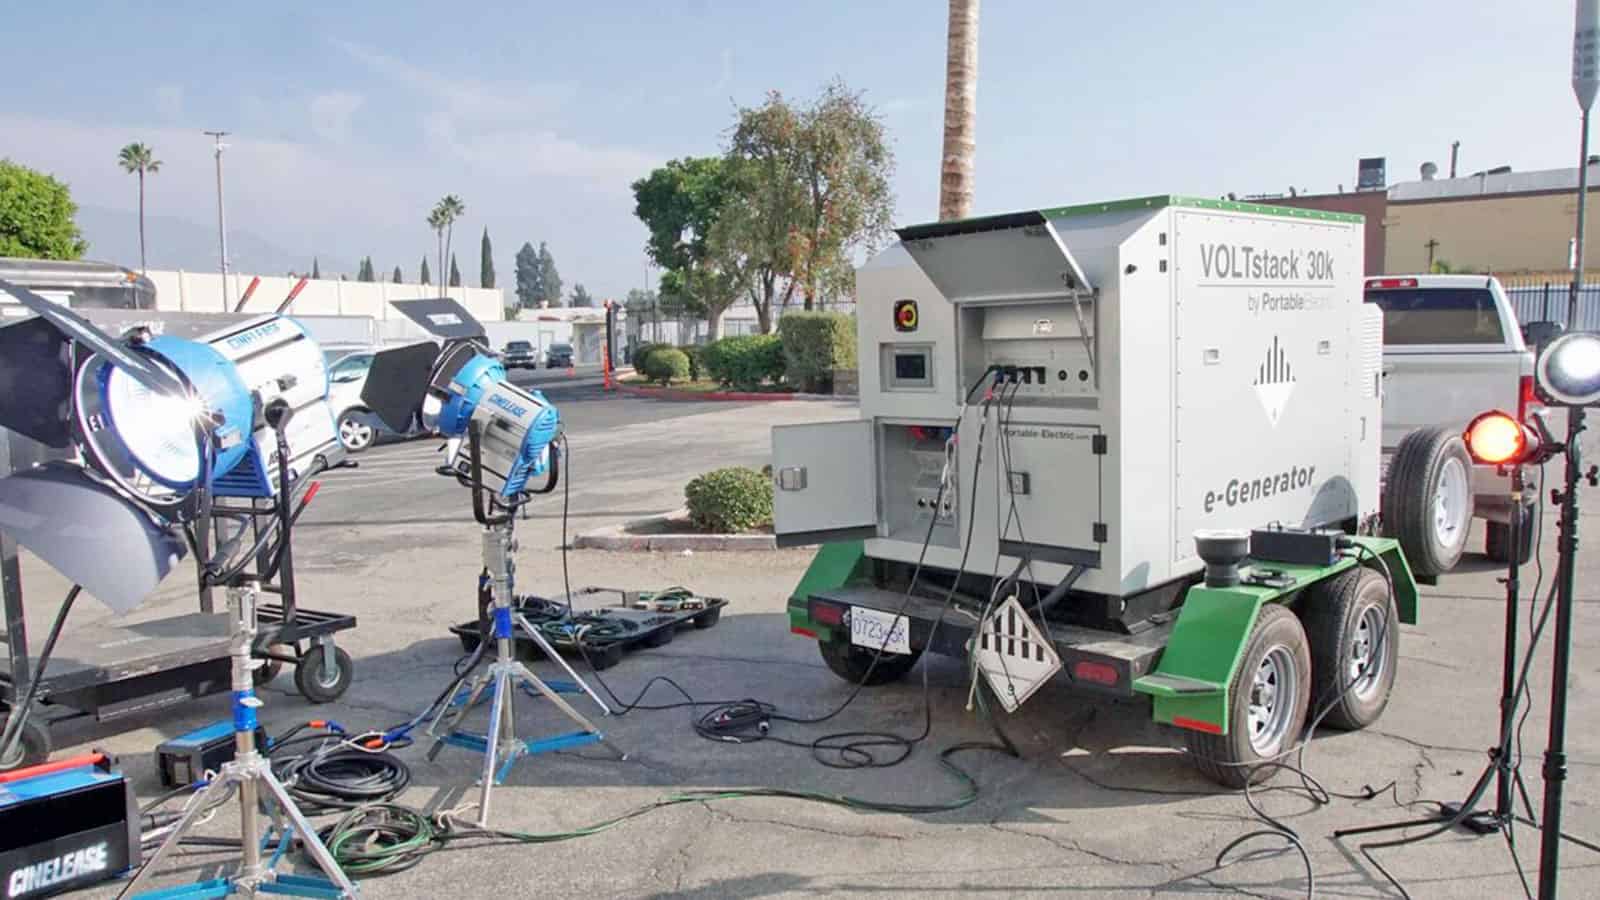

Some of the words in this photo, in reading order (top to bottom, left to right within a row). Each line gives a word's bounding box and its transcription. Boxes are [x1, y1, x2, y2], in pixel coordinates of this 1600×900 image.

[1200, 243, 1299, 279] VOLTstack
[1307, 250, 1334, 280] 30k
[1204, 465, 1315, 512] e-Generator
[8, 842, 107, 897] CINELEASE
